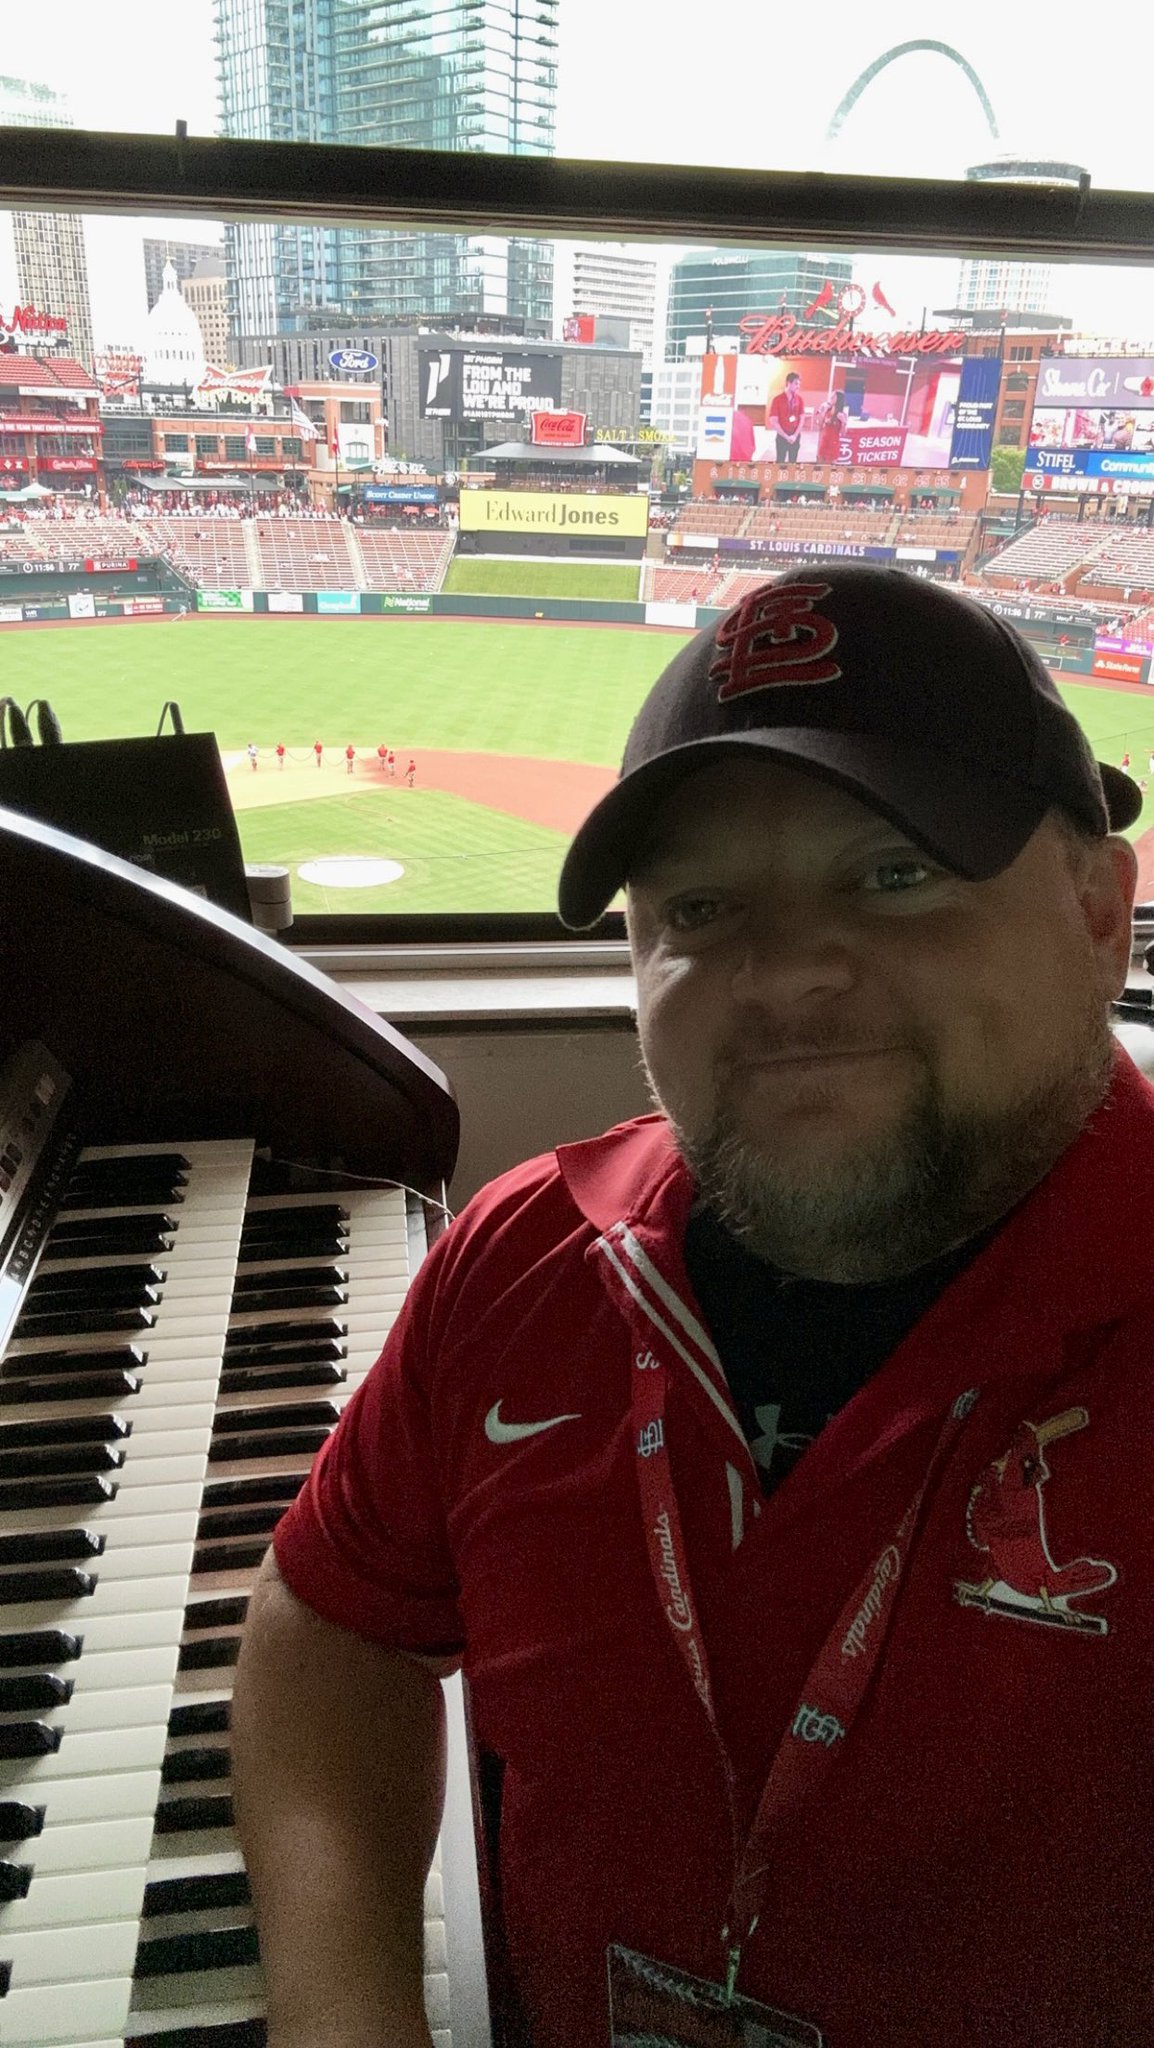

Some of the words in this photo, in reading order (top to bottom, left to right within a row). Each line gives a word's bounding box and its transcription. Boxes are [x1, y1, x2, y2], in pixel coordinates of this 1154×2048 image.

[740, 314, 967, 356] Budweiser
[339, 352, 370, 369] Ford
[463, 364, 503, 381] FROM
[504, 366, 532, 382] THE
[463, 380, 490, 395] LOU
[492, 381, 522, 396] AND
[231, 391, 272, 404] HOUSE
[463, 394, 507, 410] WE'RE
[508, 395, 554, 412] PROUD
[596, 429, 627, 441] SALT
[859, 436, 901, 449] SEASON
[856, 450, 899, 463] TICKETS
[1036, 450, 1076, 468] STIFEL
[1051, 476, 1099, 491] BROWN
[486, 500, 557, 523] Edward
[559, 503, 620, 526] Jones
[750, 540, 767, 551] ST.
[770, 542, 800, 554] LOUIS
[803, 543, 865, 556] CARDINALS
[394, 598, 430, 608] National
[143, 831, 189, 846] Model
[654, 1511, 692, 1631] Cardinals
[842, 1545, 900, 1658] Cardinals
